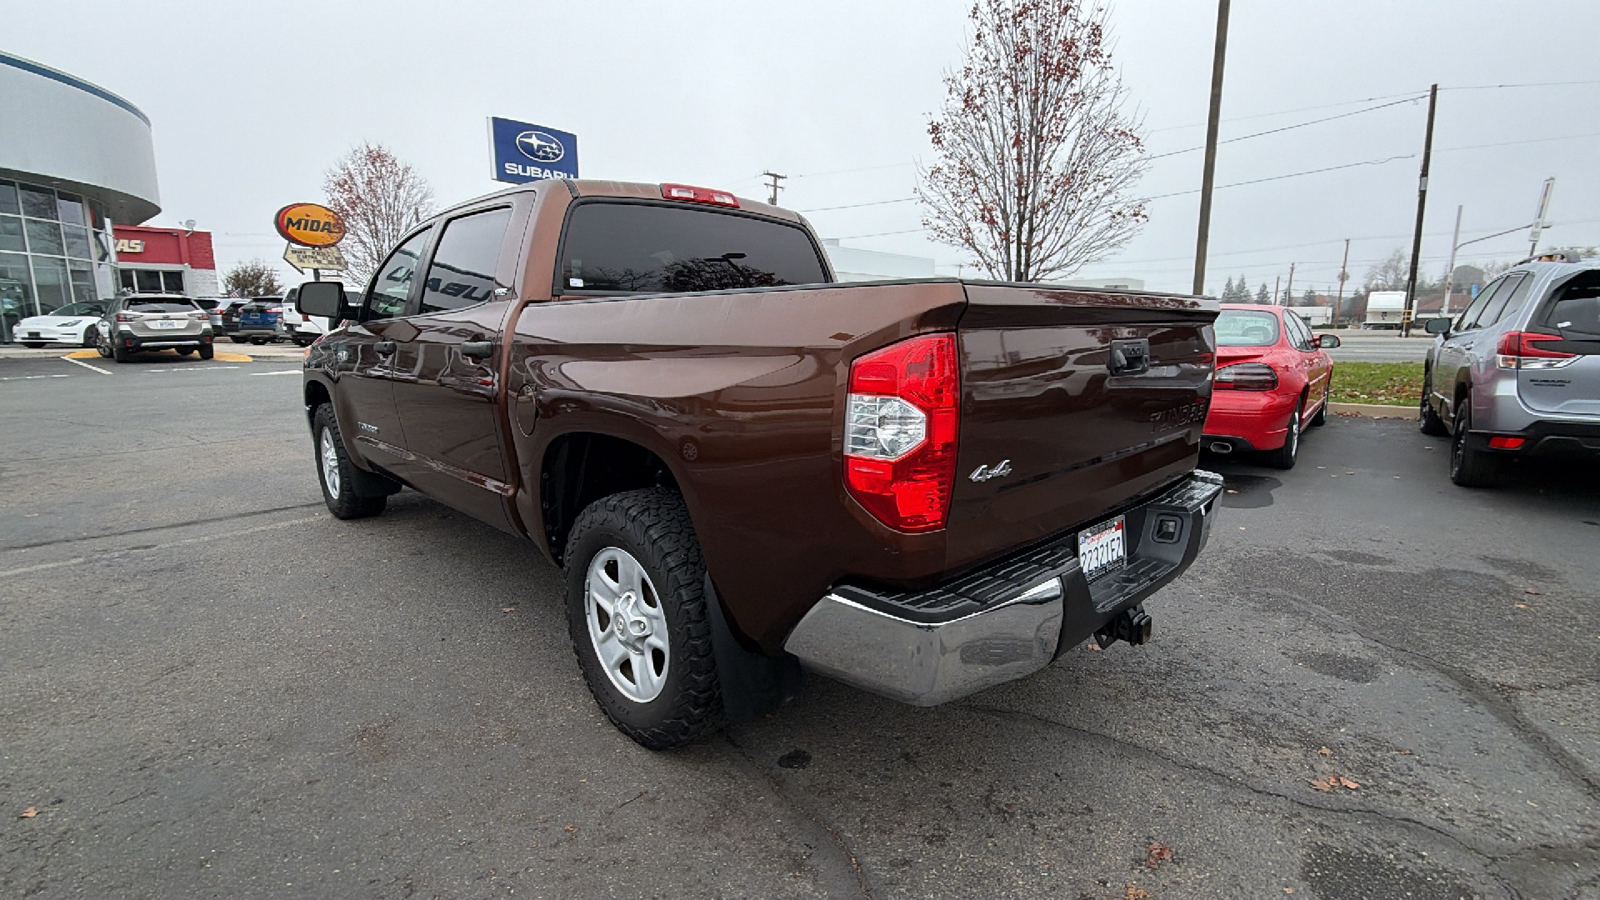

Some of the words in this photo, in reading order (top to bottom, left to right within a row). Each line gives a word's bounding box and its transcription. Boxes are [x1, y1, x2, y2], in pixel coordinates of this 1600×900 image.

[504, 162, 574, 179] SUBARU
[115, 239, 145, 253] AS
[1150, 400, 1206, 434] TUNDRA
[968, 459, 1012, 482] 4x4
